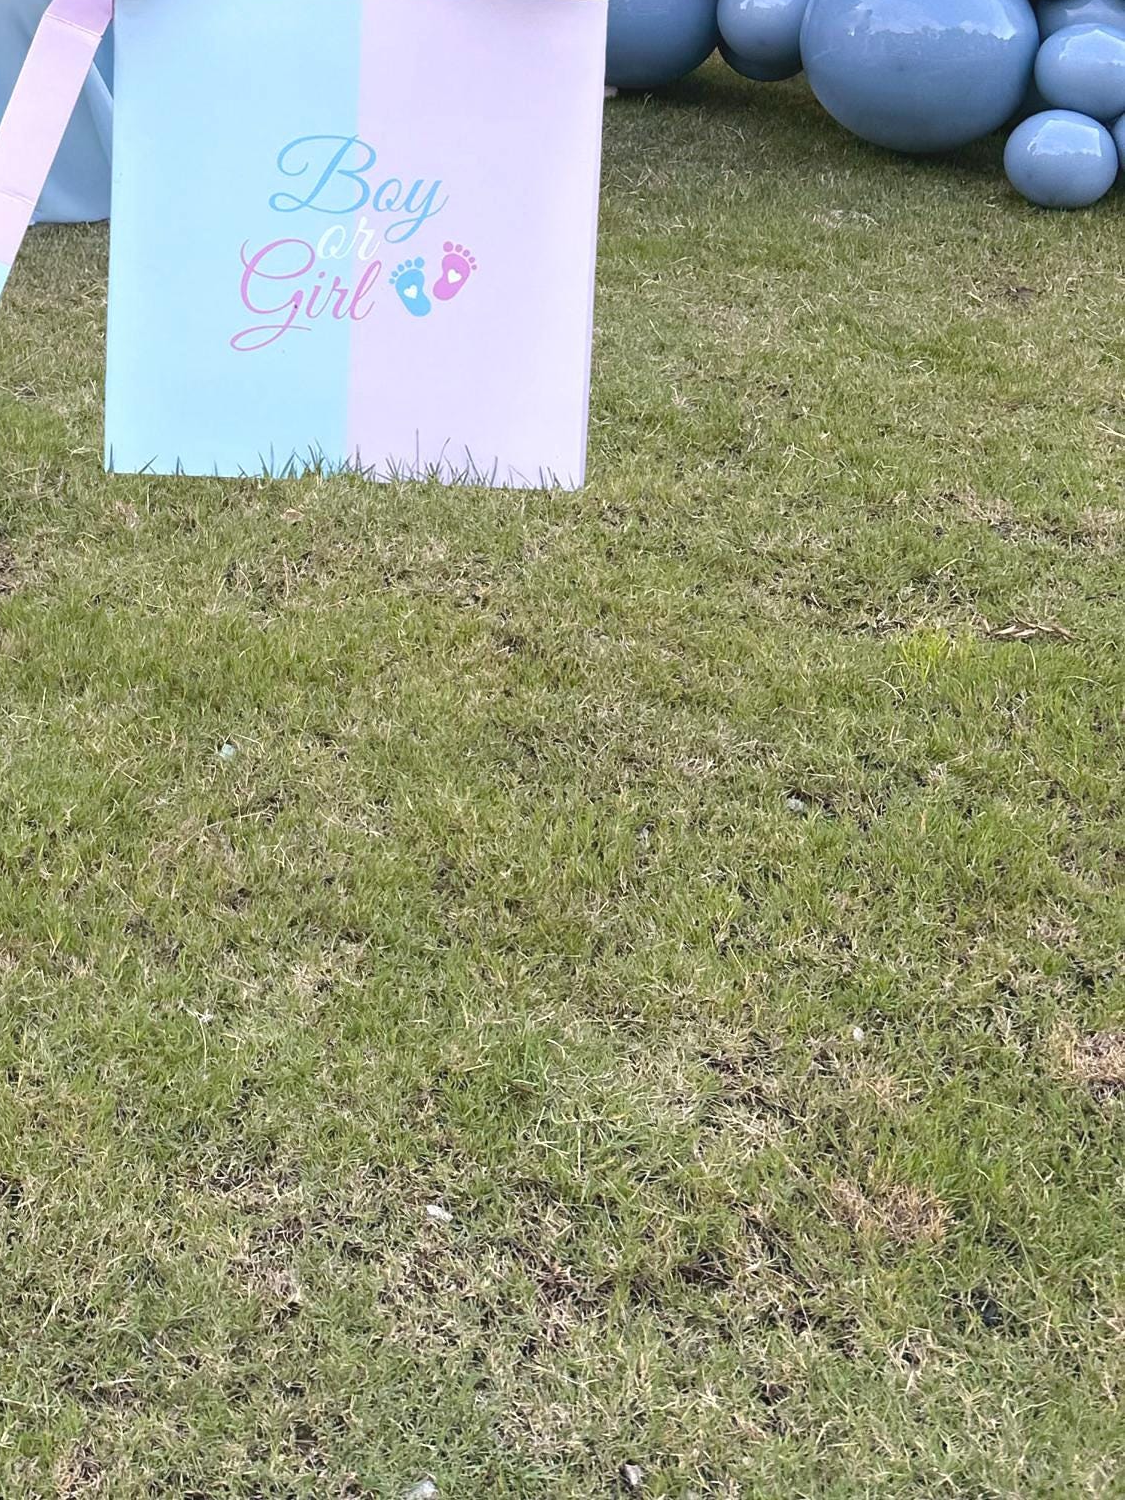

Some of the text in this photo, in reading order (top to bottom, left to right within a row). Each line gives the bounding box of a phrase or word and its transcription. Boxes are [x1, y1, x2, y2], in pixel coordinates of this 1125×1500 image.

[268, 134, 450, 244] Boy
[316, 216, 380, 261] or
[229, 238, 382, 352] Girl
